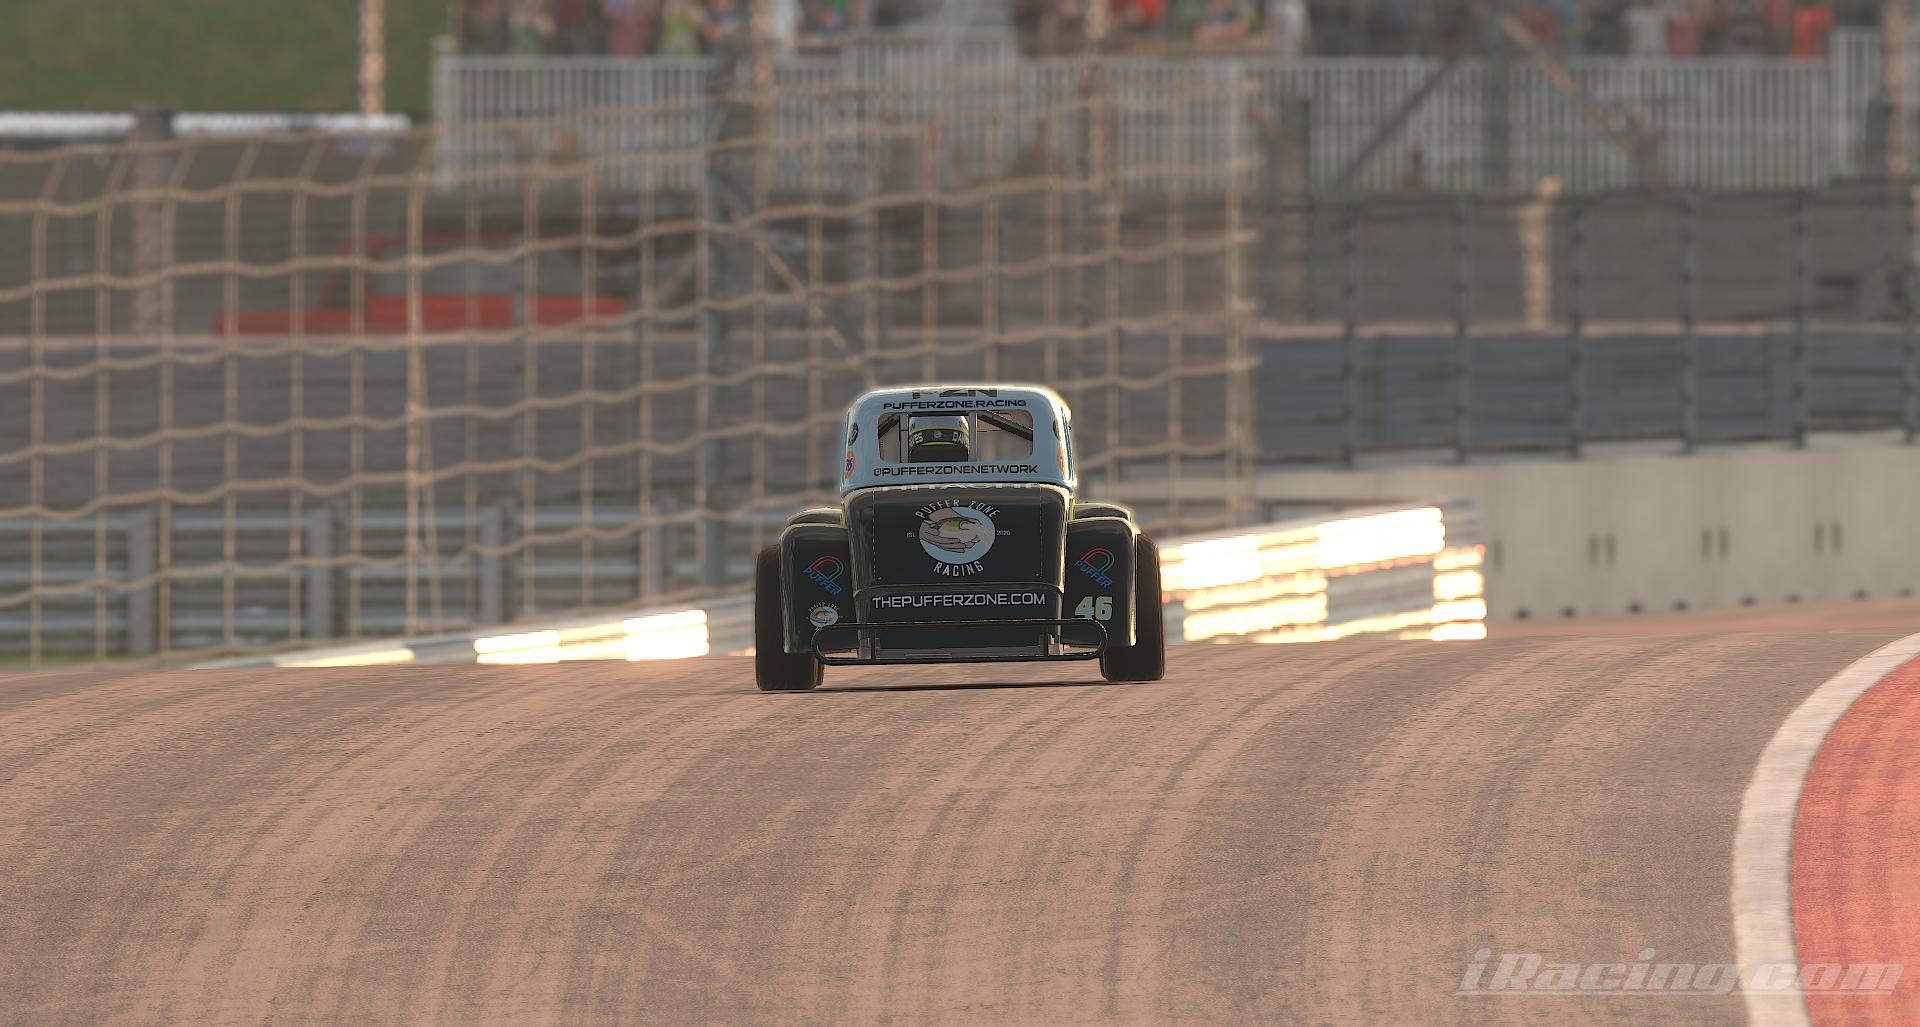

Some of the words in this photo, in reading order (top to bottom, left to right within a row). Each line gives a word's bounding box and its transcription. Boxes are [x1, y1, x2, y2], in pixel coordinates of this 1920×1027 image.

[883, 400, 1027, 410] PUFFERZONE.RACING
[915, 499, 960, 519] PUFFER
[967, 500, 1000, 518] ZONE
[933, 560, 984, 577] RACING
[1073, 559, 1113, 589] PUFFER
[802, 566, 842, 596] PUFFER
[872, 592, 1046, 609] THEPUFFERZONE.COM
[1074, 596, 1113, 621] 46
